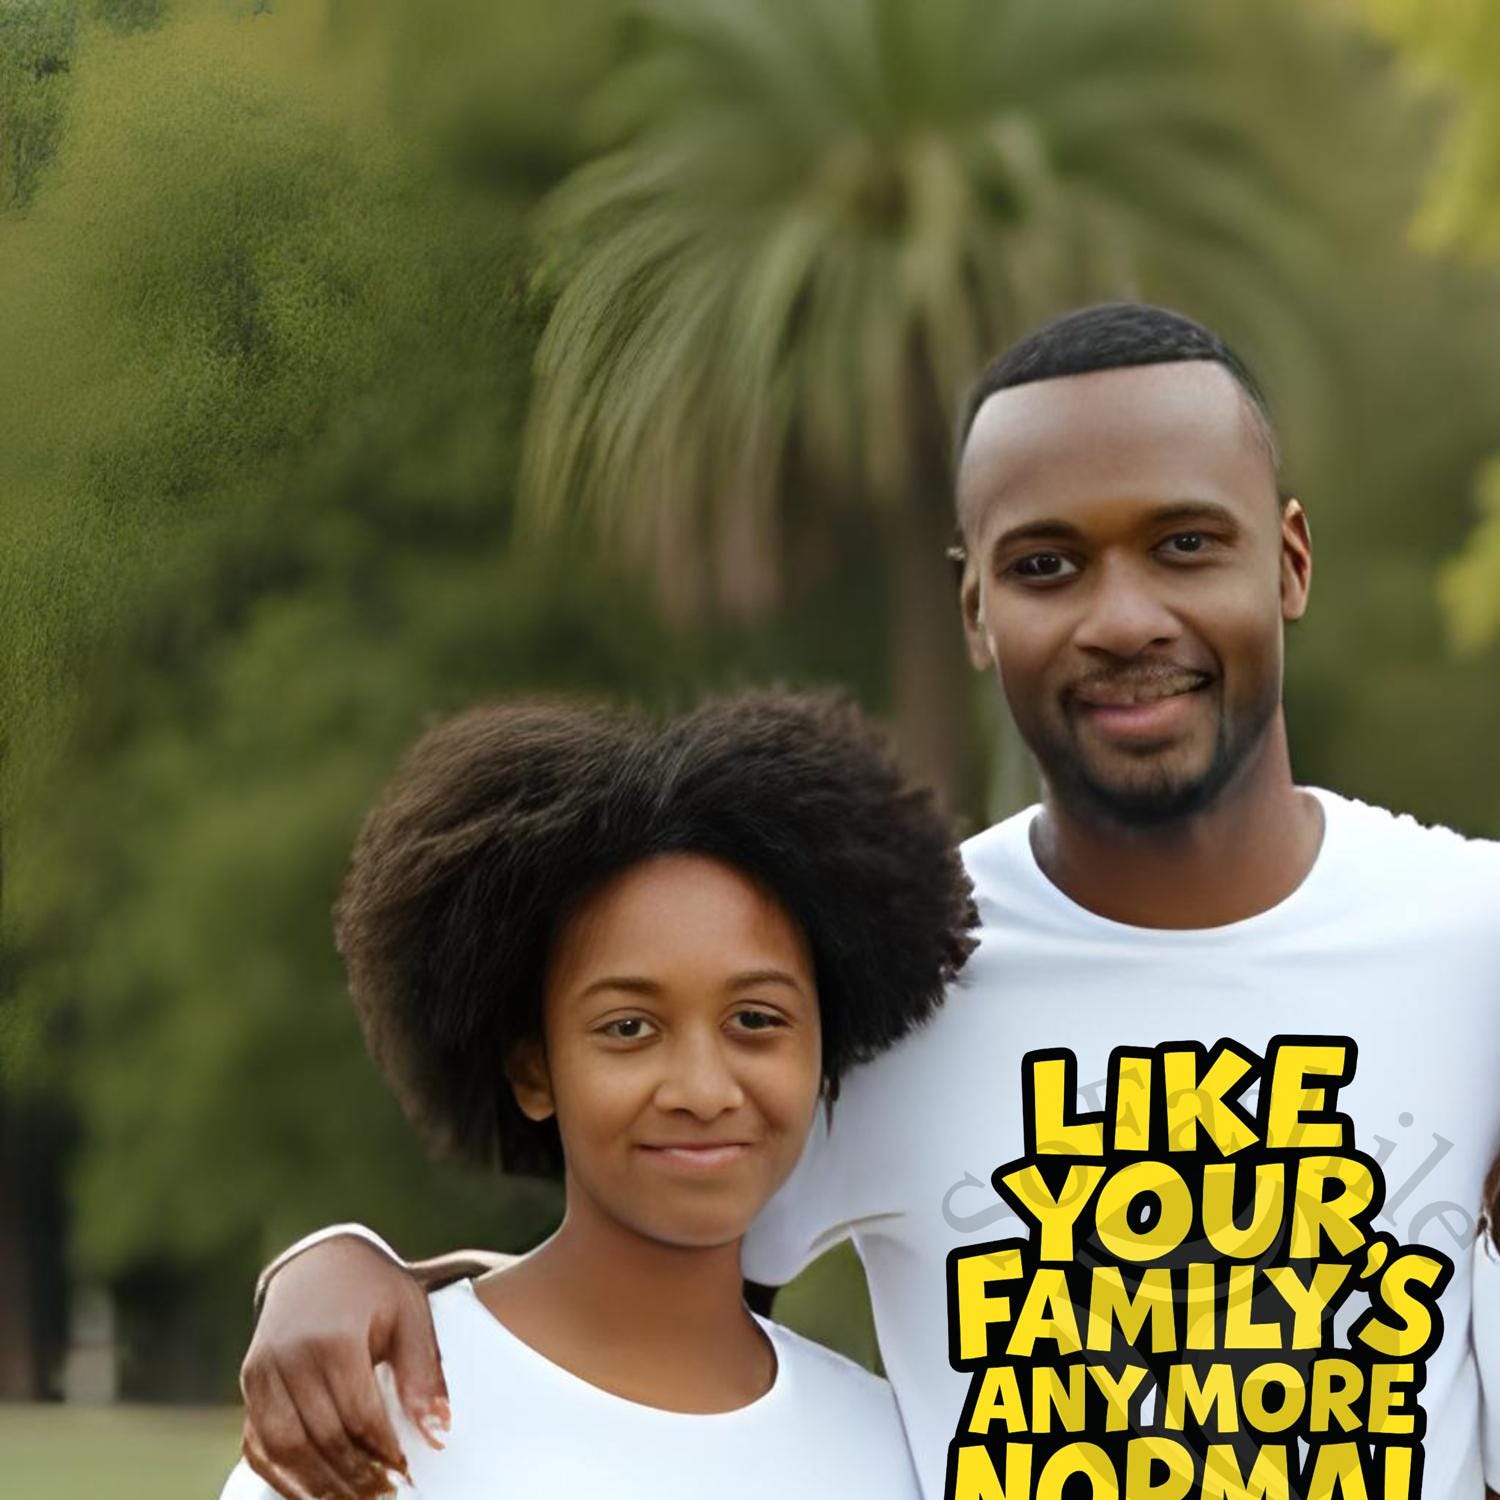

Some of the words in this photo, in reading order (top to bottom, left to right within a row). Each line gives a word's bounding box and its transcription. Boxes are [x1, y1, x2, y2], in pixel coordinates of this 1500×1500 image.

[1030, 1042, 1349, 1160] LIKE
[998, 1152, 1377, 1265] YOUR
[954, 1238, 1445, 1363] FAMILY'S
[965, 1360, 1151, 1438] ANY
[1161, 1355, 1418, 1437] MORE
